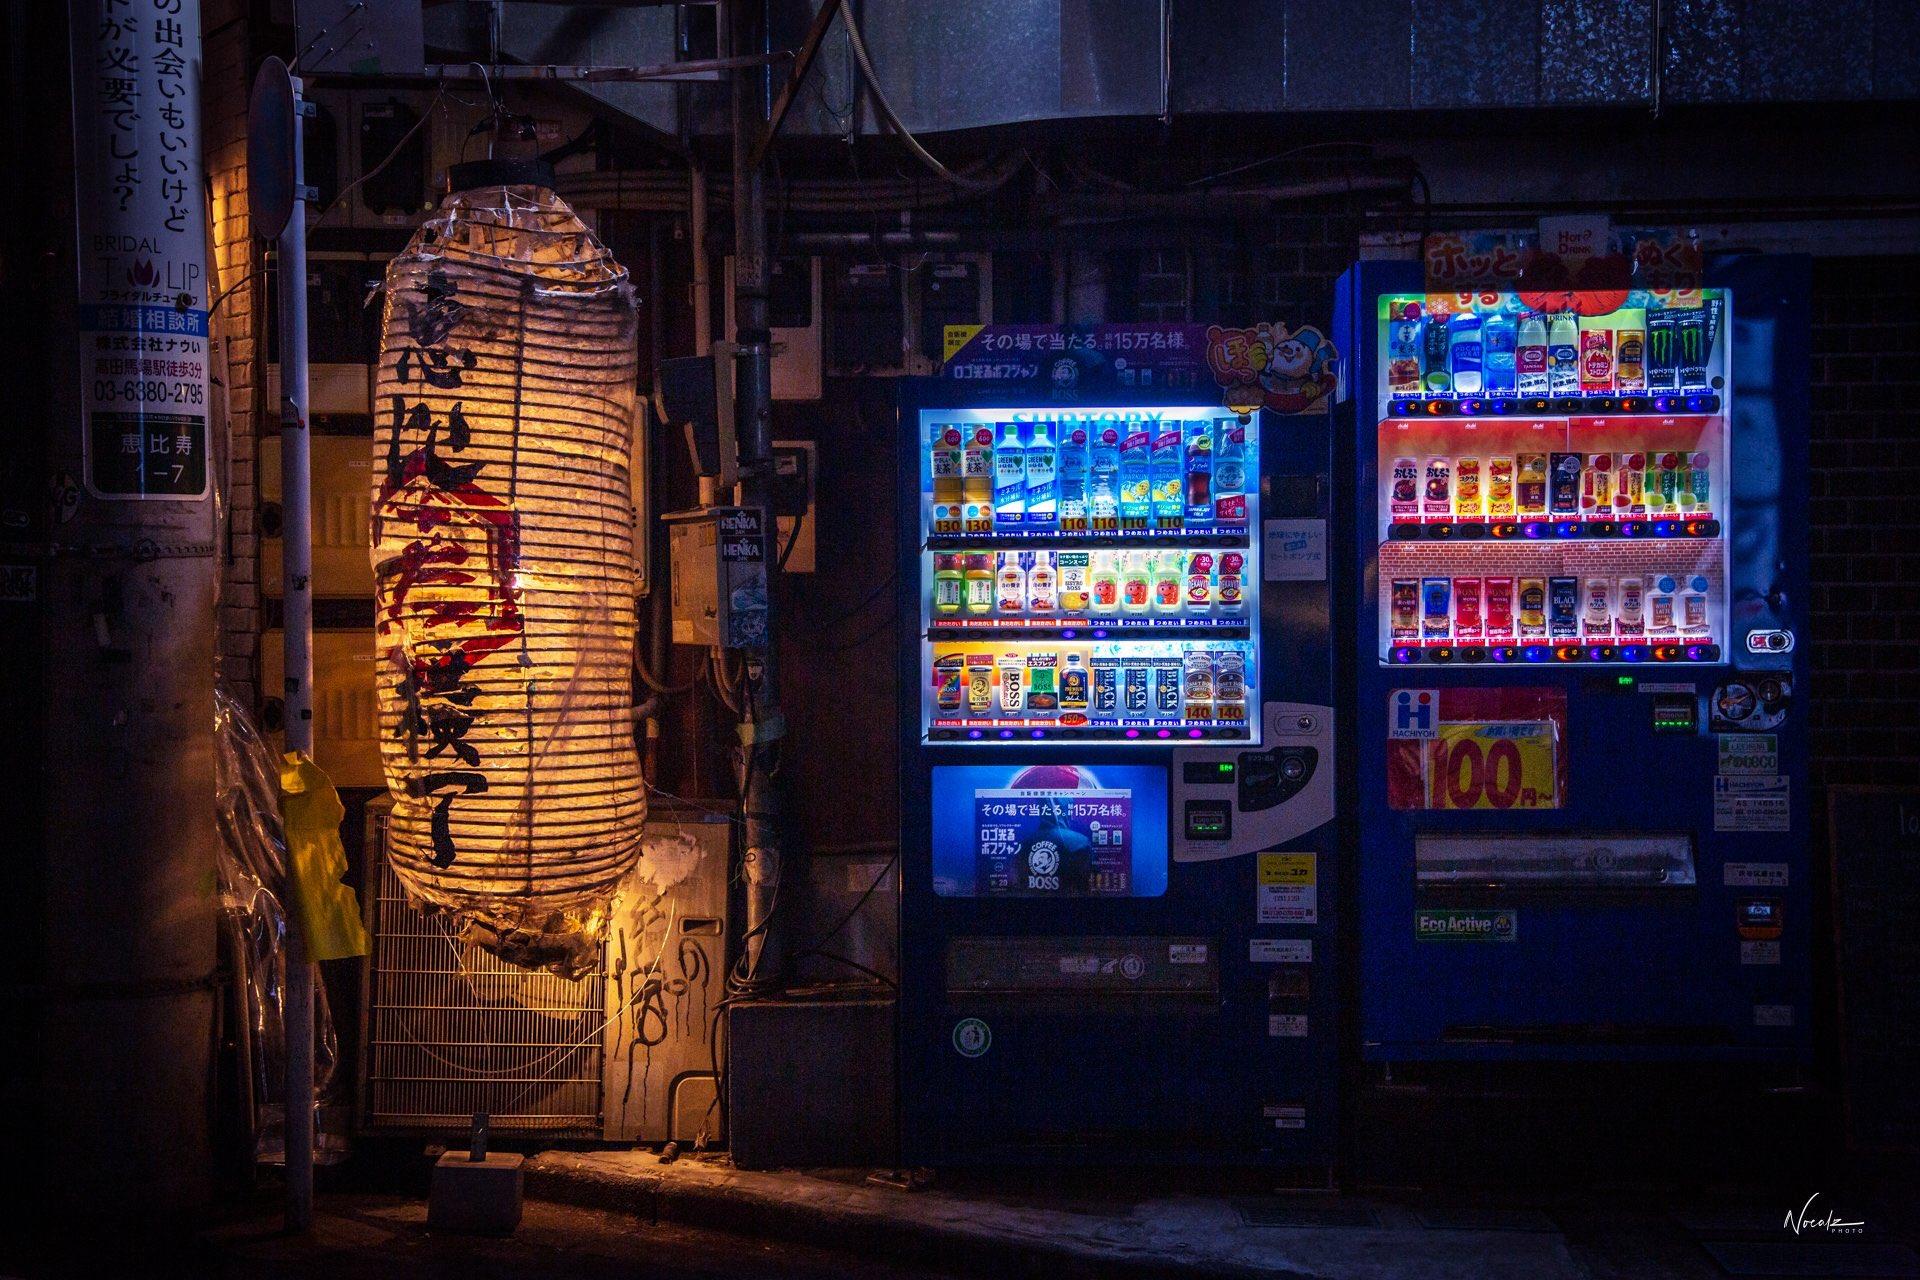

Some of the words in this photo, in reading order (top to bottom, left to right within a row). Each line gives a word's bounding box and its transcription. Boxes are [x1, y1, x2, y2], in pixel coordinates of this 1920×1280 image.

[93, 235, 162, 254] BRIDAL
[97, 308, 200, 333] 結婚相談所
[94, 381, 203, 405] 03-6380-2795
[121, 432, 192, 456] 恵比寿
[1394, 468, 1418, 478] おしるこ
[1426, 467, 1450, 478] おしるこ
[1010, 672, 1020, 708] BOSS
[1104, 671, 1115, 708] BLACK
[1136, 671, 1147, 708] BLACK
[1167, 671, 1178, 708] BLACK
[982, 803, 1066, 817] その場で当たる。
[981, 828, 1015, 841] ロゴ光る
[981, 842, 1022, 854] ボスジャン
[1031, 841, 1057, 852] COFFEE
[1028, 876, 1060, 890] BOSS
